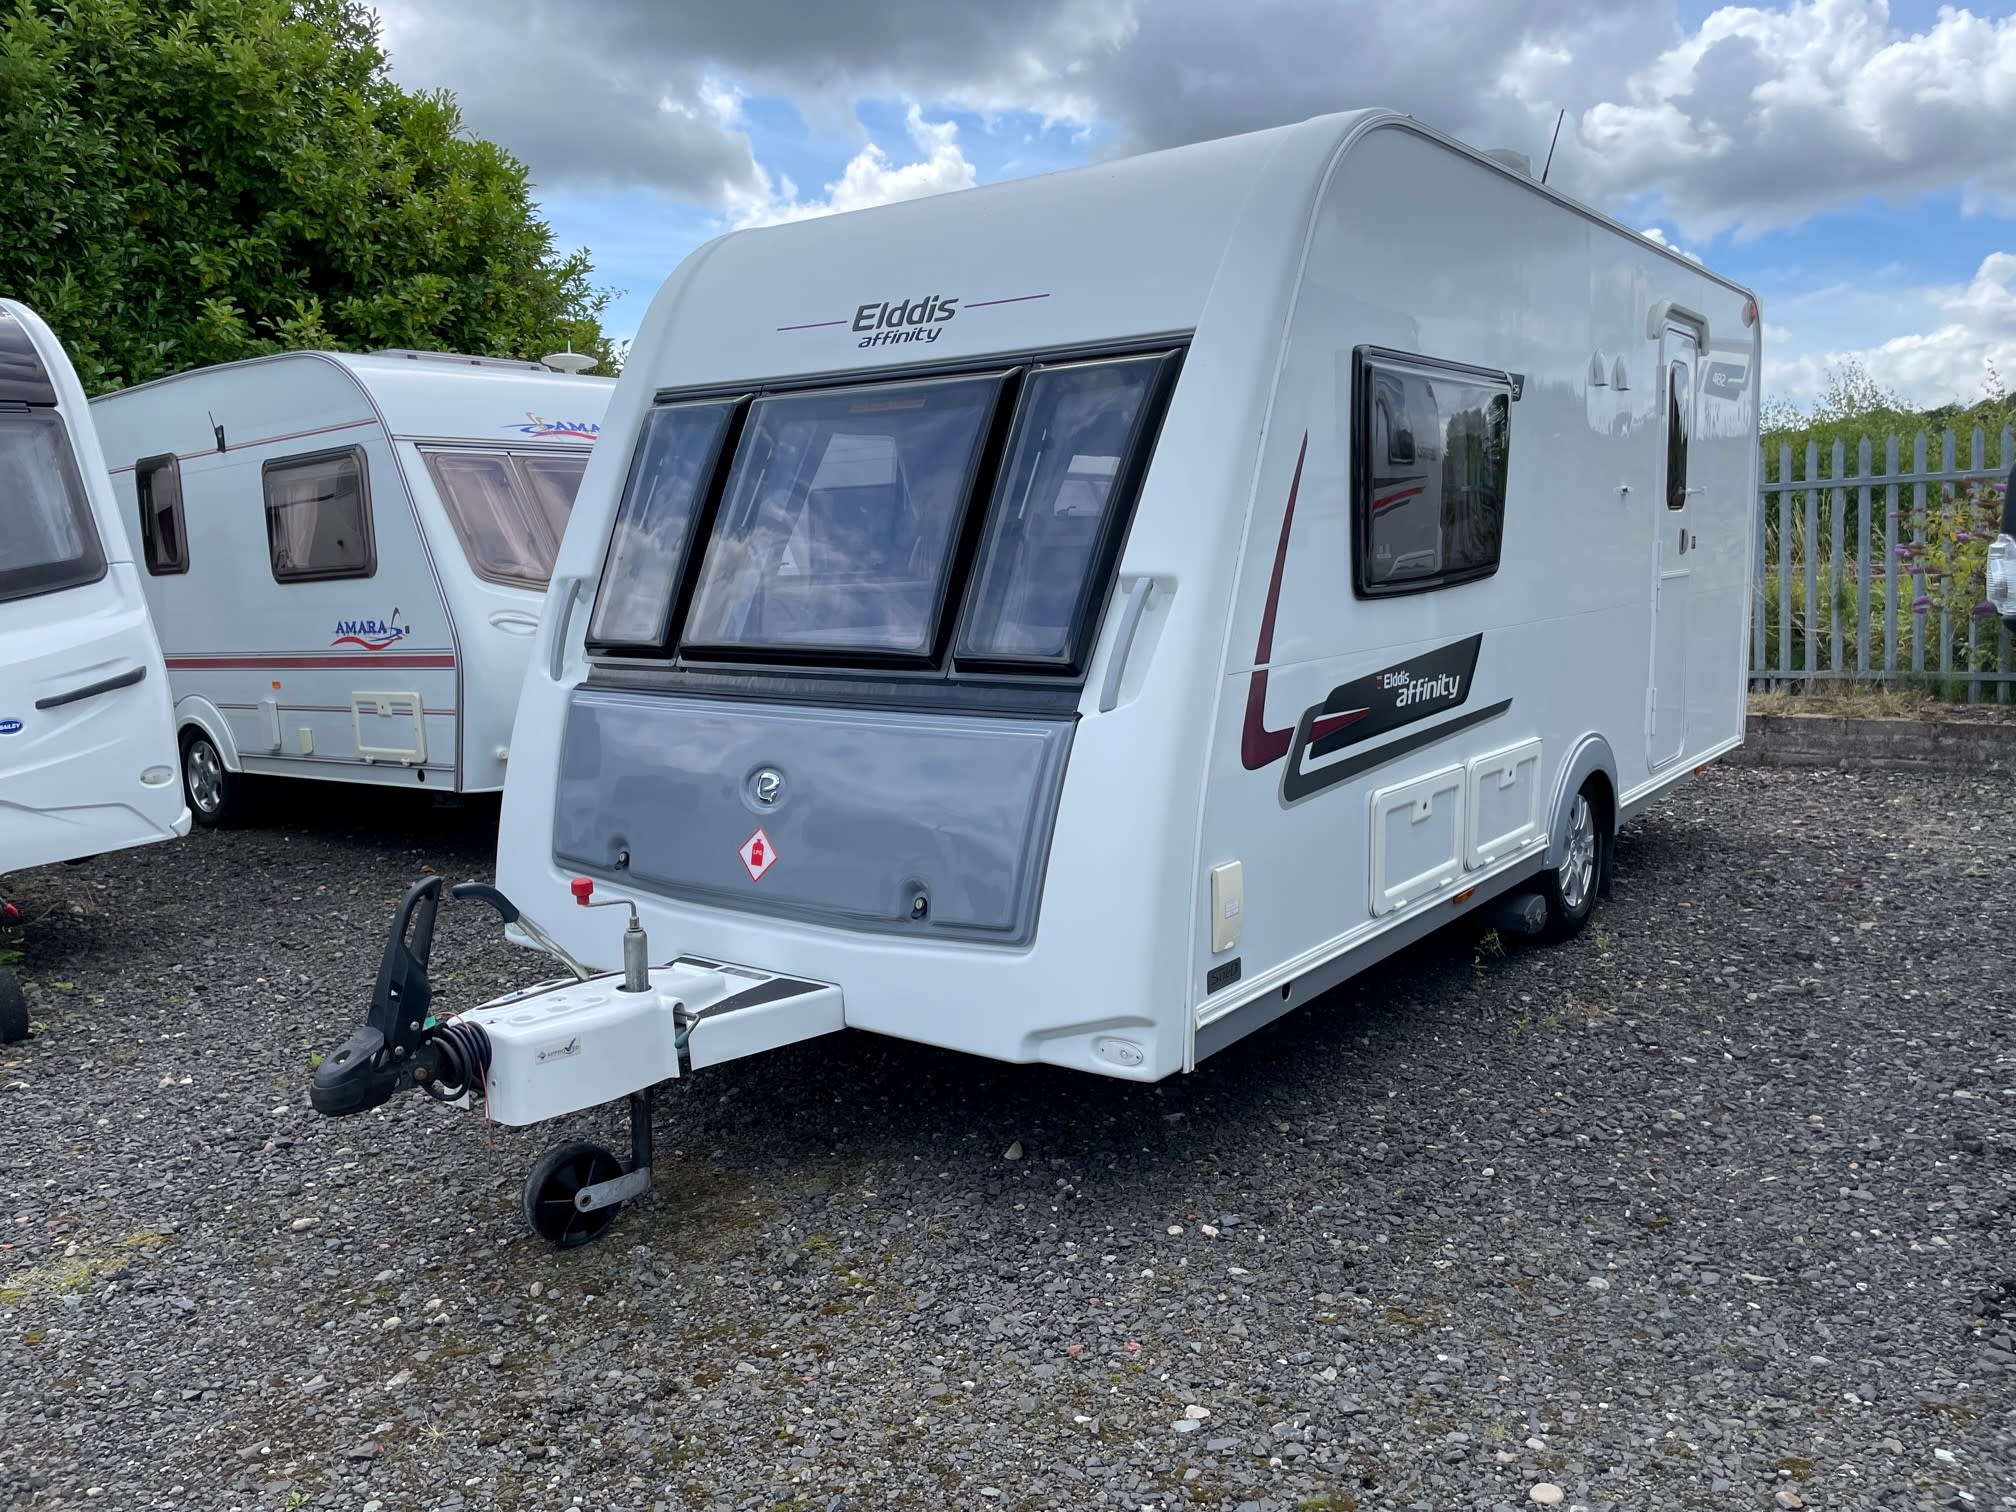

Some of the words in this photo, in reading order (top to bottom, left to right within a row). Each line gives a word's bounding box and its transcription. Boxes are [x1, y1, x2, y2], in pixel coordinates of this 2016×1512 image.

[852, 295, 959, 332] Elddis
[858, 326, 943, 348] affinity
[336, 619, 388, 635] AMARA
[1383, 670, 1410, 689] Elddis
[1396, 673, 1460, 708] affinity
